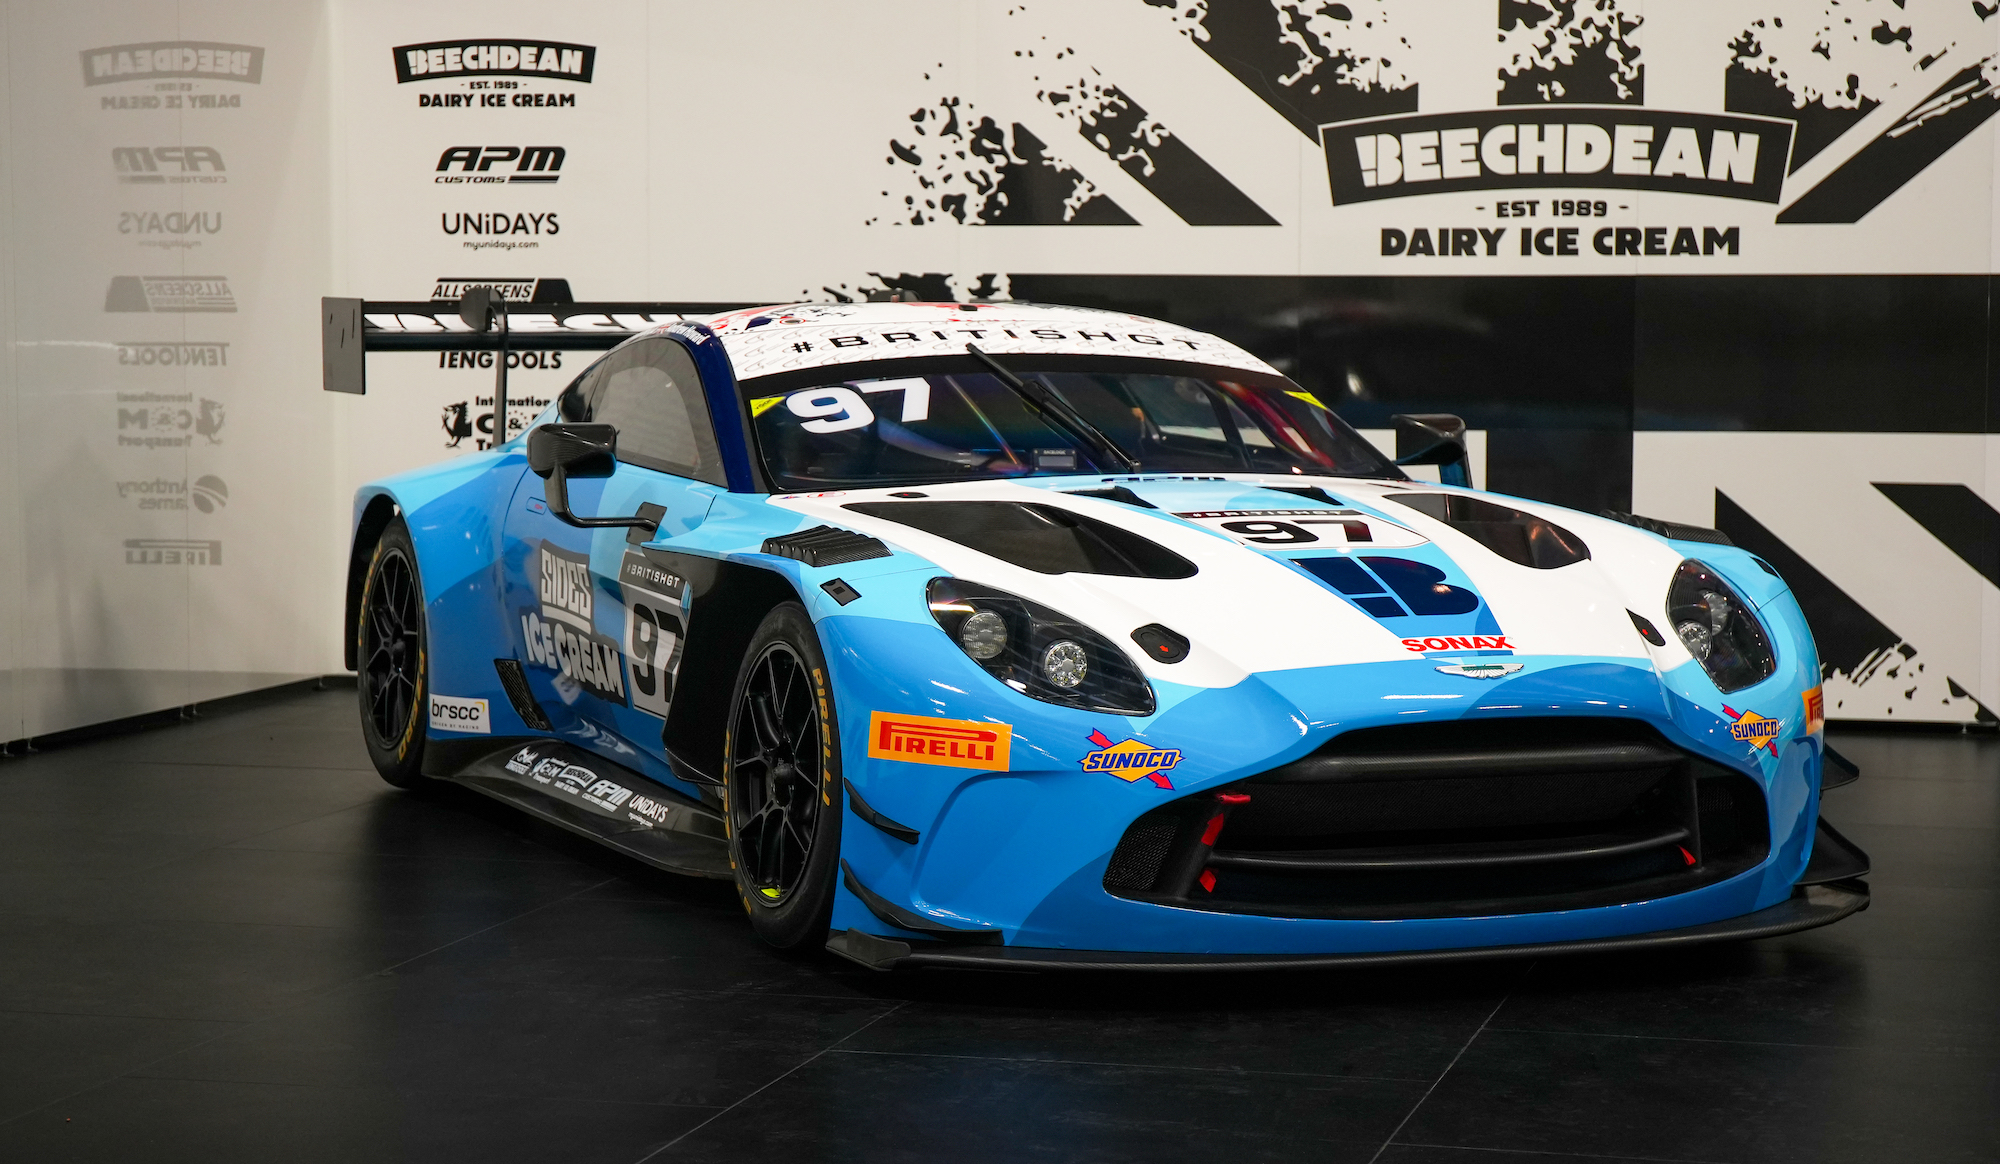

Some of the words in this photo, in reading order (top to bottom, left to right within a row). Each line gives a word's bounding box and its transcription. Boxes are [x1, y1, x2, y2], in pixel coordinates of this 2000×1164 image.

[406, 45, 583, 76] BEECHDEAN
[494, 81, 518, 90] 1989
[419, 93, 474, 108] DAIRY
[480, 93, 506, 108] ICE
[512, 93, 576, 108] CREAM
[435, 146, 566, 172] APM
[1355, 123, 1761, 189] BEECHDEAN
[434, 175, 507, 184] CUSTOMS
[1497, 200, 1540, 218] EST
[1552, 200, 1608, 218] 1989
[463, 239, 539, 251] myunidays.com
[1381, 227, 1507, 257] DAIRY
[1521, 227, 1579, 257] ICE
[1593, 227, 1740, 257] CREAM
[791, 328, 1201, 353] #BRITISHGT
[785, 376, 931, 434] 97
[1220, 519, 1374, 544] 97
[541, 548, 592, 620] SIDES
[521, 611, 558, 670] ICE
[554, 622, 625, 699] CREAM
[632, 602, 688, 703] 97
[1401, 635, 1518, 653] SONAX
[431, 698, 480, 721] brscc
[812, 667, 831, 807] PIRELLI
[878, 720, 998, 762] PIRELLI
[1732, 720, 1778, 739] SUNOCO
[1086, 750, 1177, 770] SUNOCO
[586, 779, 634, 807] APM
